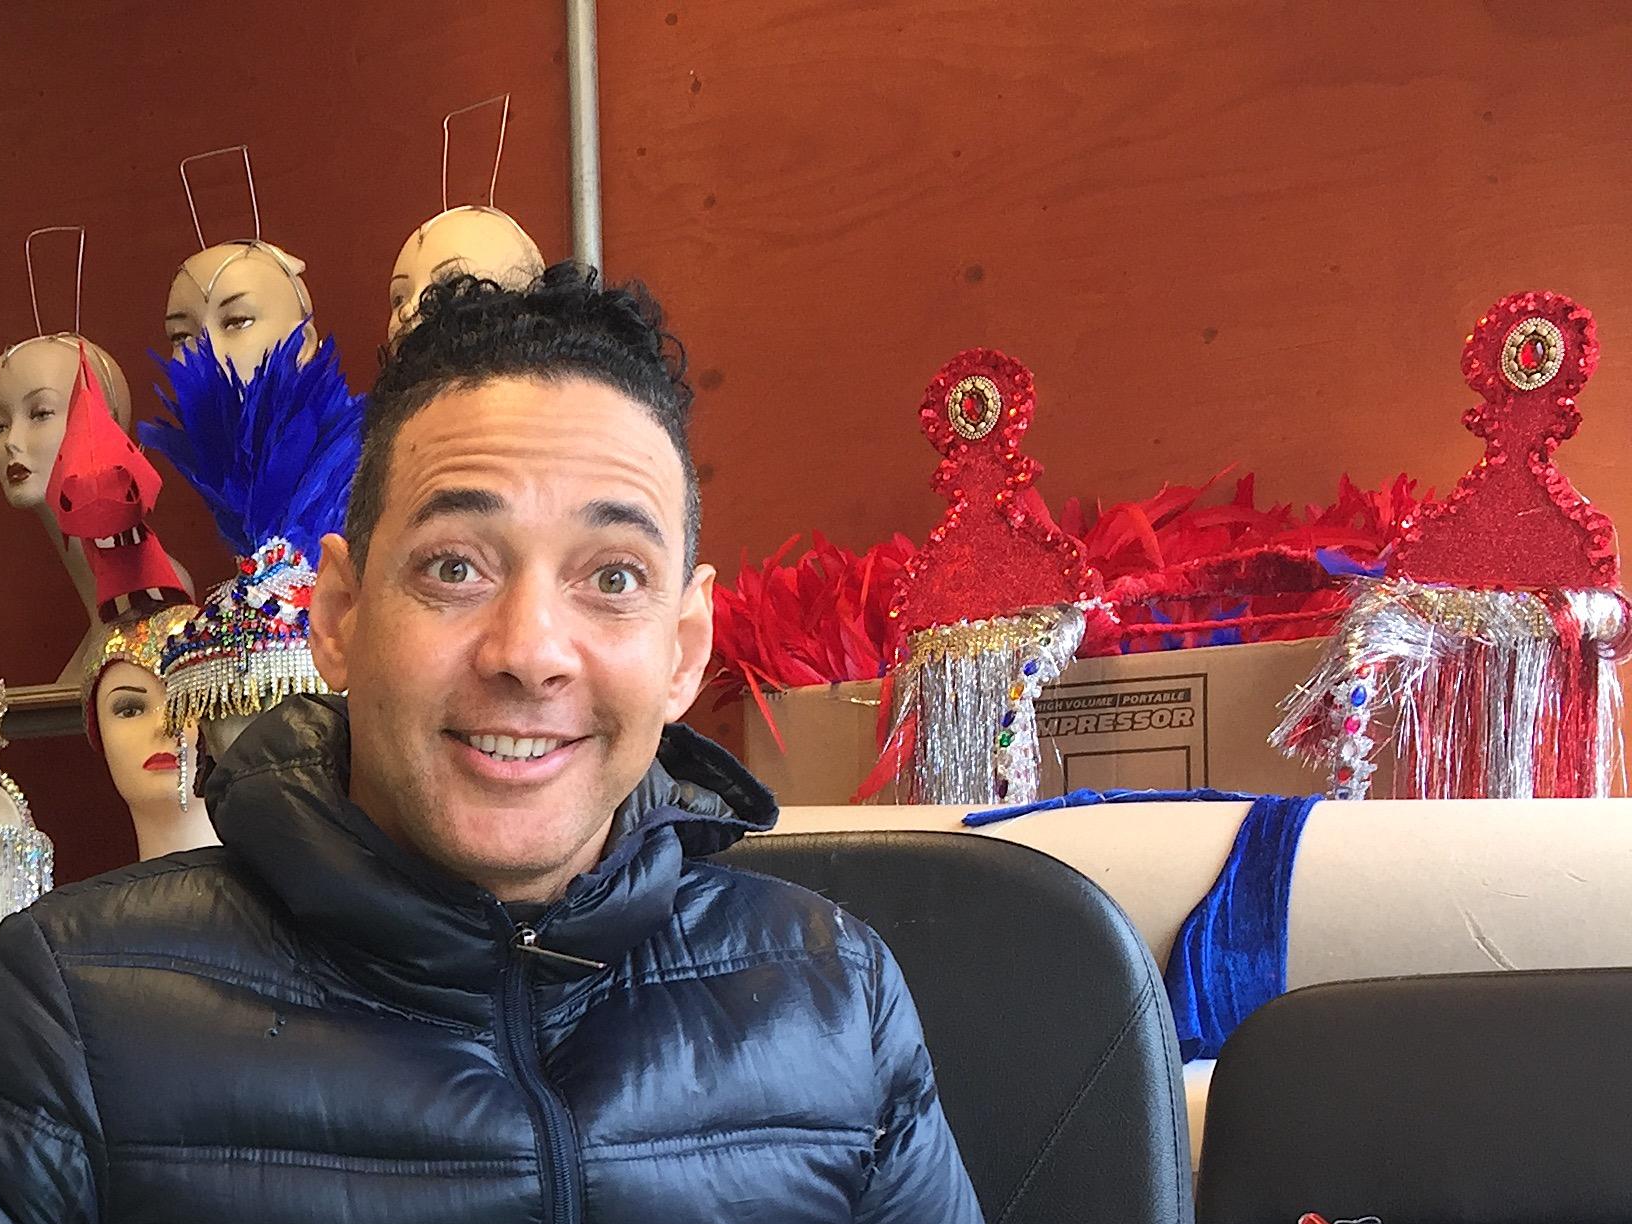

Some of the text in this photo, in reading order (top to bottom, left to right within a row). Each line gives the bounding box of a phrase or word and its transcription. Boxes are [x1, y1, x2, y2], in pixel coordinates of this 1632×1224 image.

[1035, 691, 1186, 713] HIGH VOLUME PORTABLE
[1036, 707, 1195, 738] MPRESSOR
